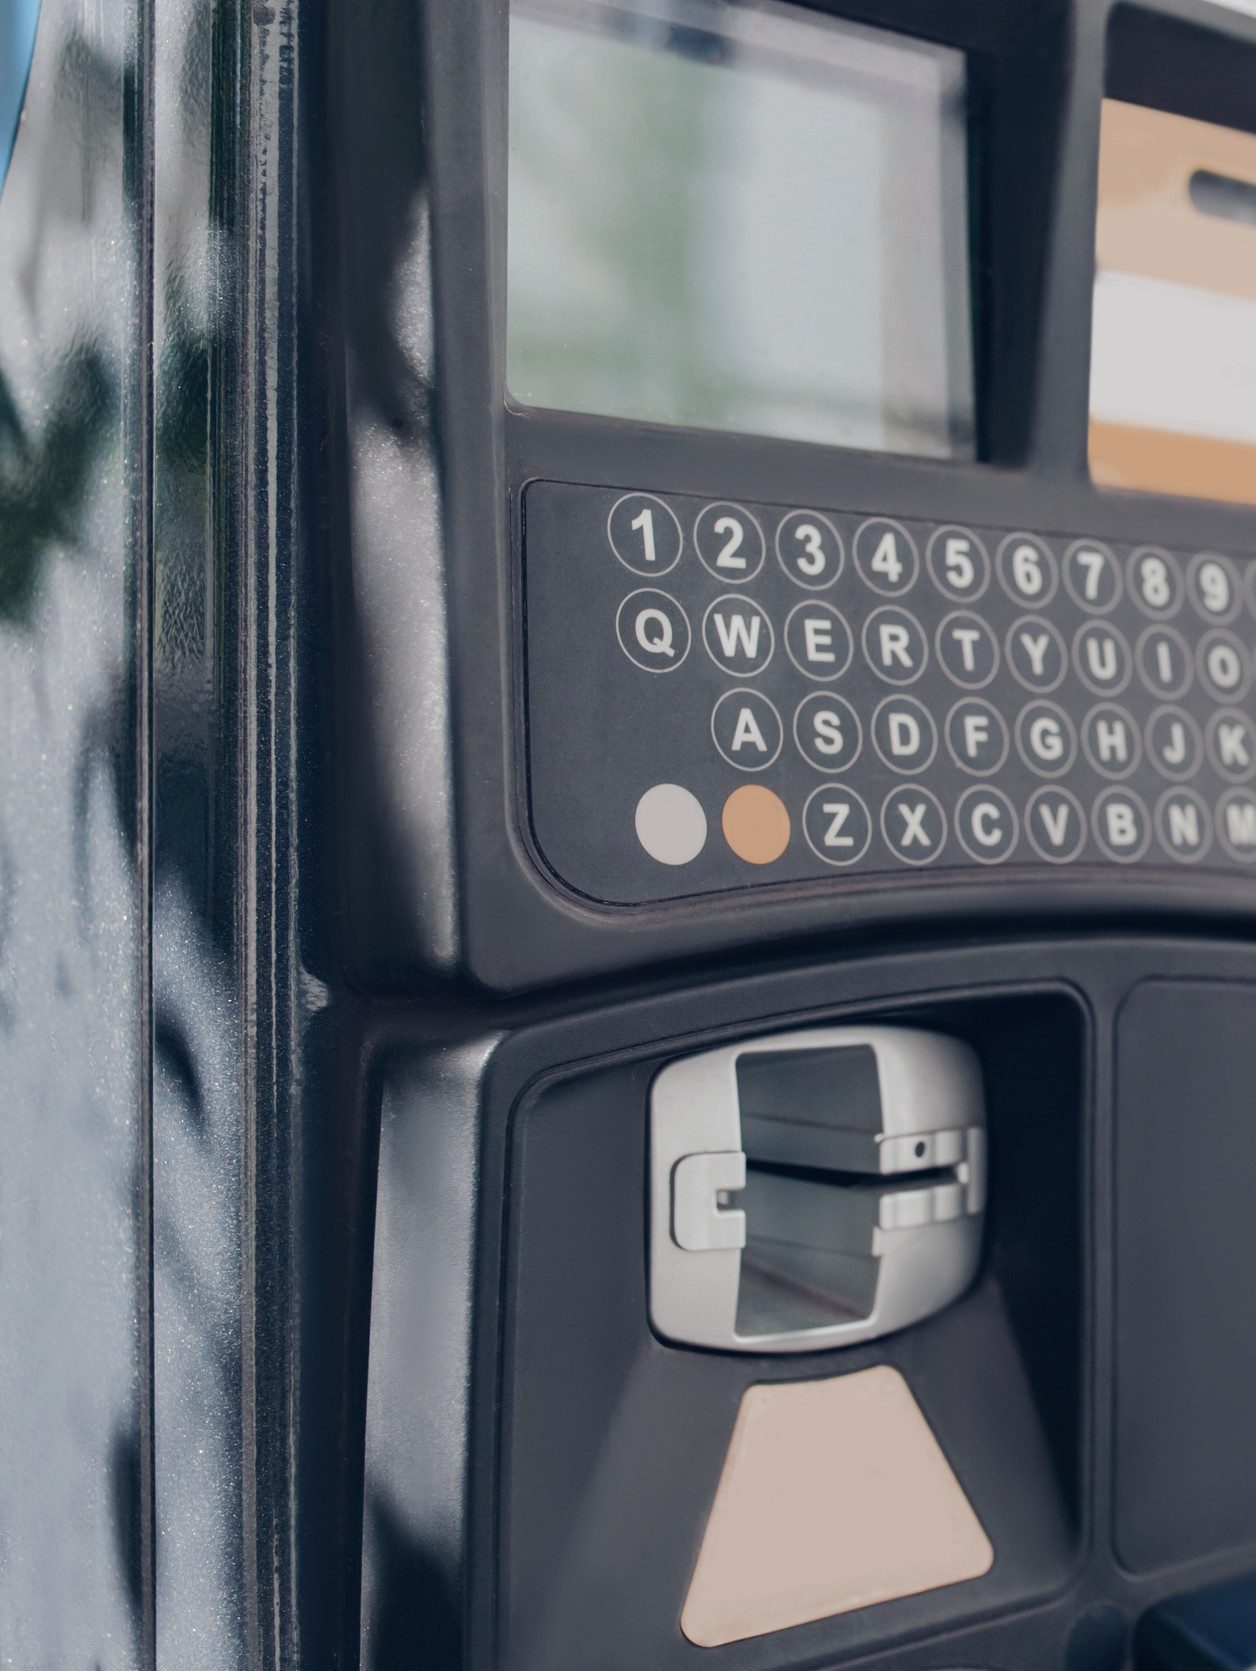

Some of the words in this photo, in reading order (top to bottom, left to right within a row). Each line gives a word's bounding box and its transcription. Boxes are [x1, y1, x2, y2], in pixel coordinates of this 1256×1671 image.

[632, 509, 655, 561] 1
[714, 517, 746, 568] 2
[795, 525, 825, 575] 3
[872, 533, 902, 582] 4
[946, 539, 973, 587] 5
[1013, 546, 1042, 594] 6
[1078, 552, 1104, 599] 7
[1142, 558, 1169, 605] 8
[1201, 564, 1228, 611] 9
[635, 609, 674, 657] Q
[714, 614, 760, 658] W
[805, 619, 835, 662] E
[880, 625, 913, 667] R
[953, 629, 979, 671] T
[1021, 634, 1049, 675] Y
[1087, 639, 1116, 679] U
[1157, 643, 1171, 682] I
[1209, 646, 1239, 687] O
[732, 708, 767, 751] A
[814, 711, 843, 754] S
[889, 713, 919, 755] D
[964, 716, 988, 756] F
[1031, 718, 1063, 759] G
[1097, 721, 1126, 761] H
[1164, 723, 1185, 763] J
[1220, 726, 1249, 764] K
[823, 804, 853, 846] Z
[899, 804, 930, 845] X
[972, 803, 1002, 845] C
[1040, 805, 1068, 845] V
[1107, 804, 1136, 845] B
[1170, 805, 1198, 844] N
